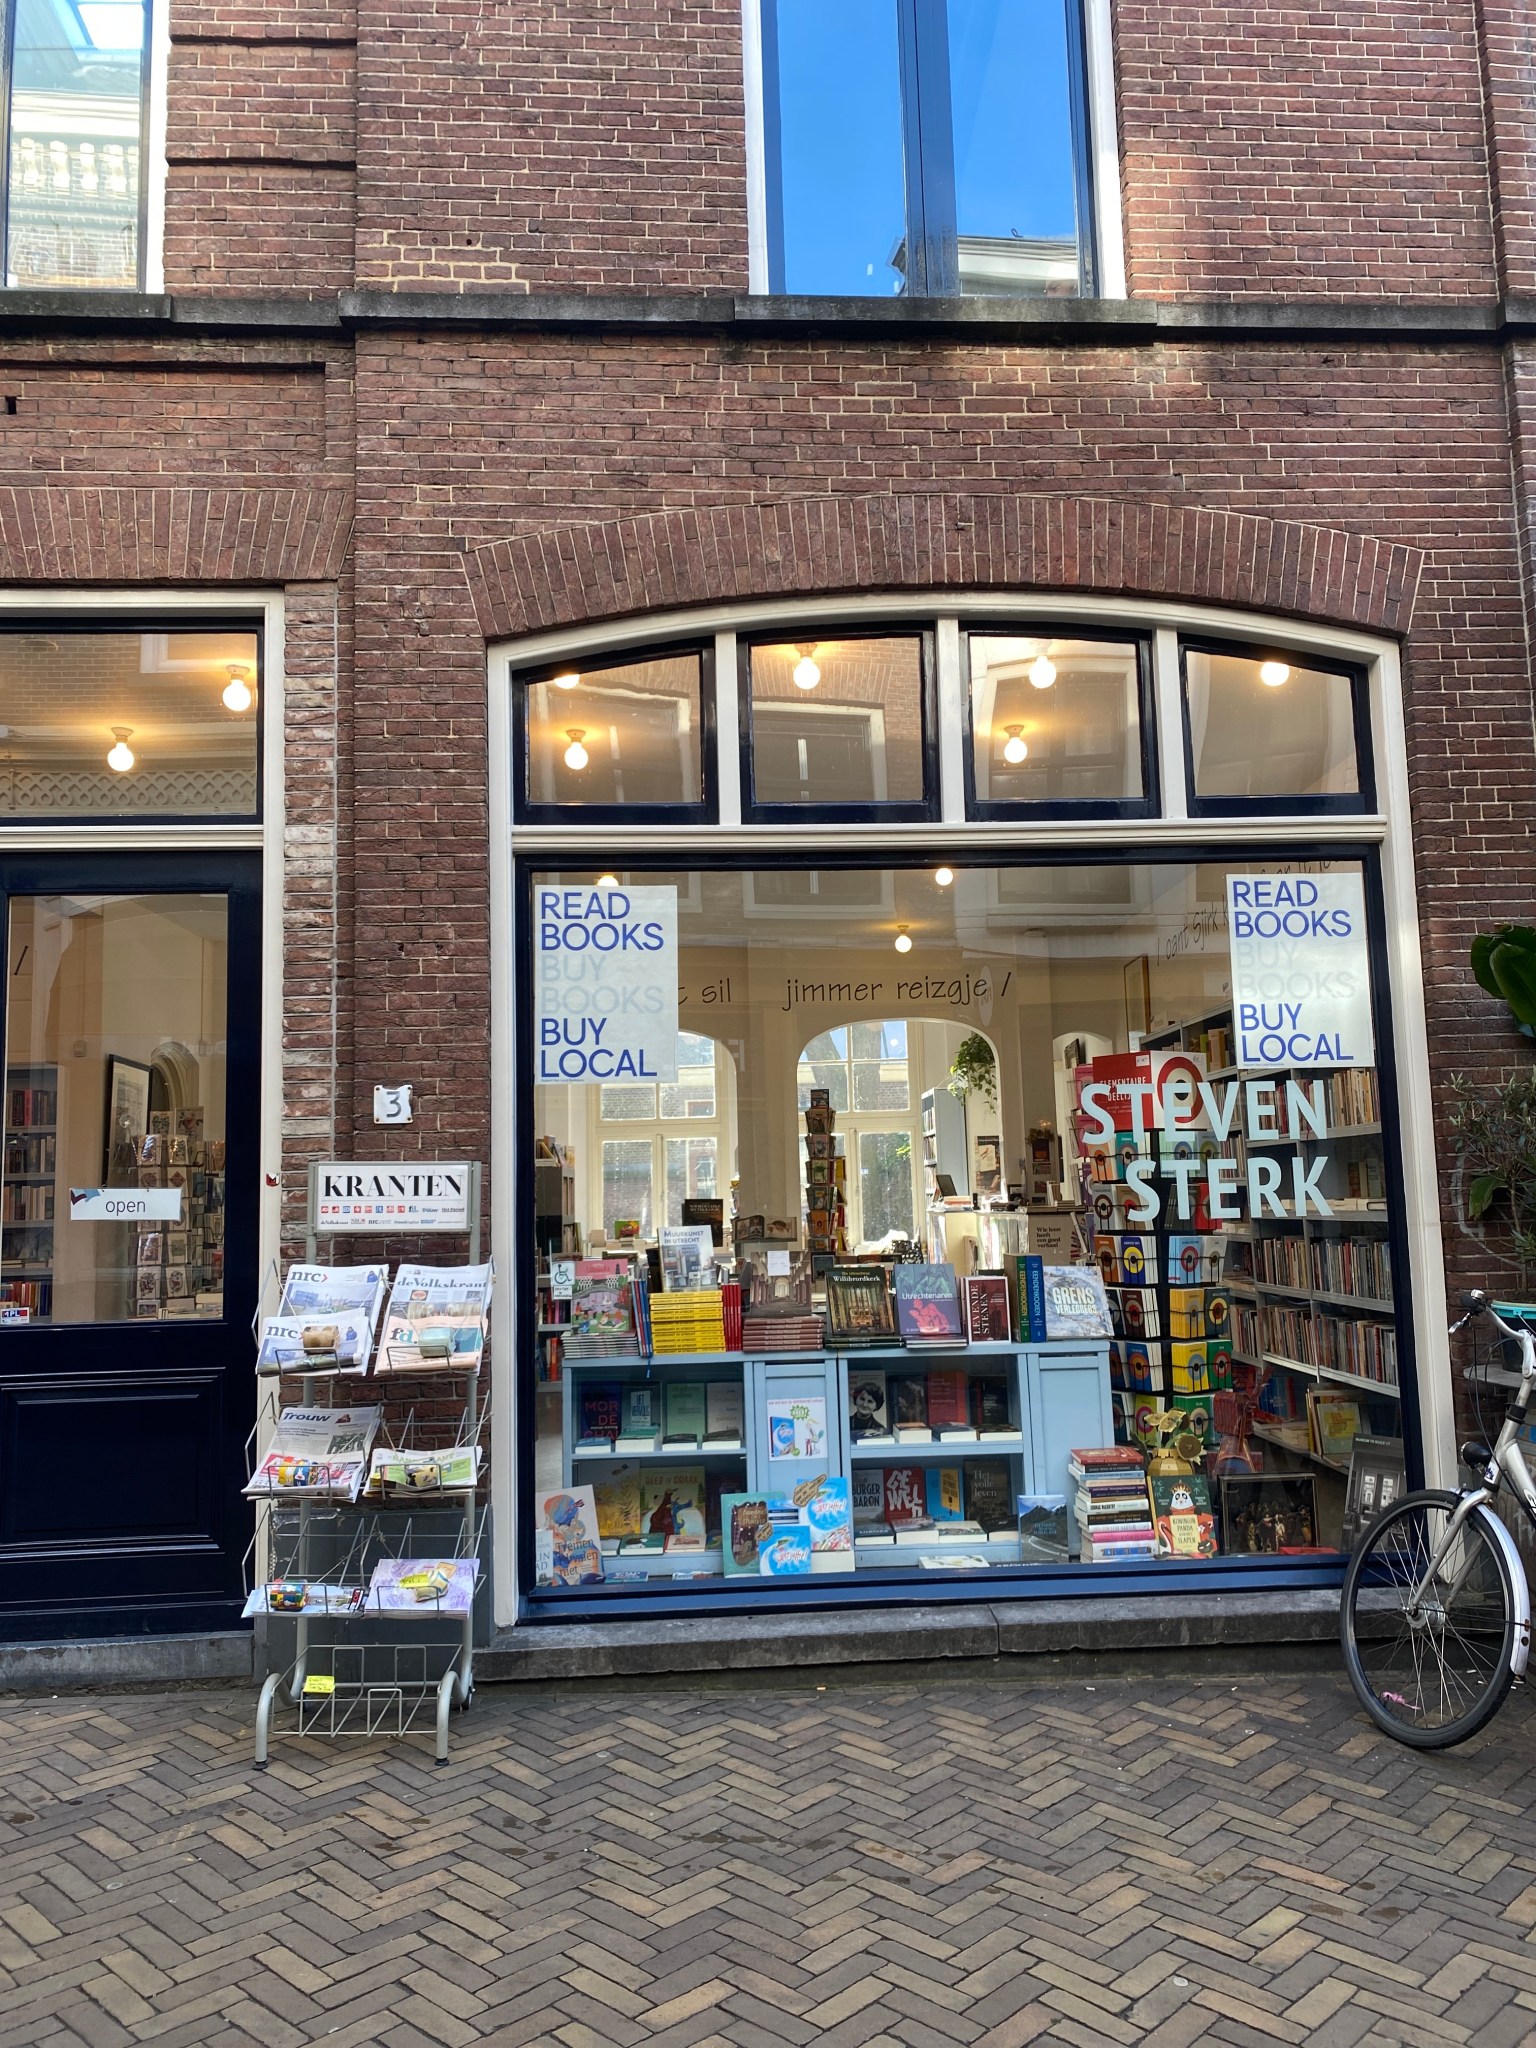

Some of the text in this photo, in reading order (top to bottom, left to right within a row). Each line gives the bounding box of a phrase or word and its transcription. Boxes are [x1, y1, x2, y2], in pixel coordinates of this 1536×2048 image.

[540, 892, 630, 919] READ
[1232, 880, 1318, 908] READ
[540, 923, 664, 951] BOOKS
[1234, 910, 1352, 938] BOOKS
[541, 954, 607, 982] BUY
[1237, 941, 1299, 969] BUY
[541, 985, 664, 1014] BOOKS
[701, 978, 731, 1003] sil
[782, 978, 882, 1011] jimmer
[897, 973, 987, 1005] reizgje
[1238, 972, 1356, 1000] BOOKS
[1239, 1003, 1303, 1031] BUY
[540, 1018, 607, 1045] BUY
[1241, 1033, 1354, 1062] LOCAL
[540, 1049, 658, 1078] LOCAL
[386, 1090, 402, 1118] 3
[1080, 1080, 1328, 1145] STEVEN
[321, 1174, 465, 1197] KRANTEN
[1125, 1156, 1335, 1222] STERK
[105, 1200, 146, 1217] open
[1052, 1287, 1095, 1305] GRENS
[283, 1412, 332, 1422] Trouw
[852, 1483, 881, 1495] BURGER
[853, 1496, 880, 1508] BARON
